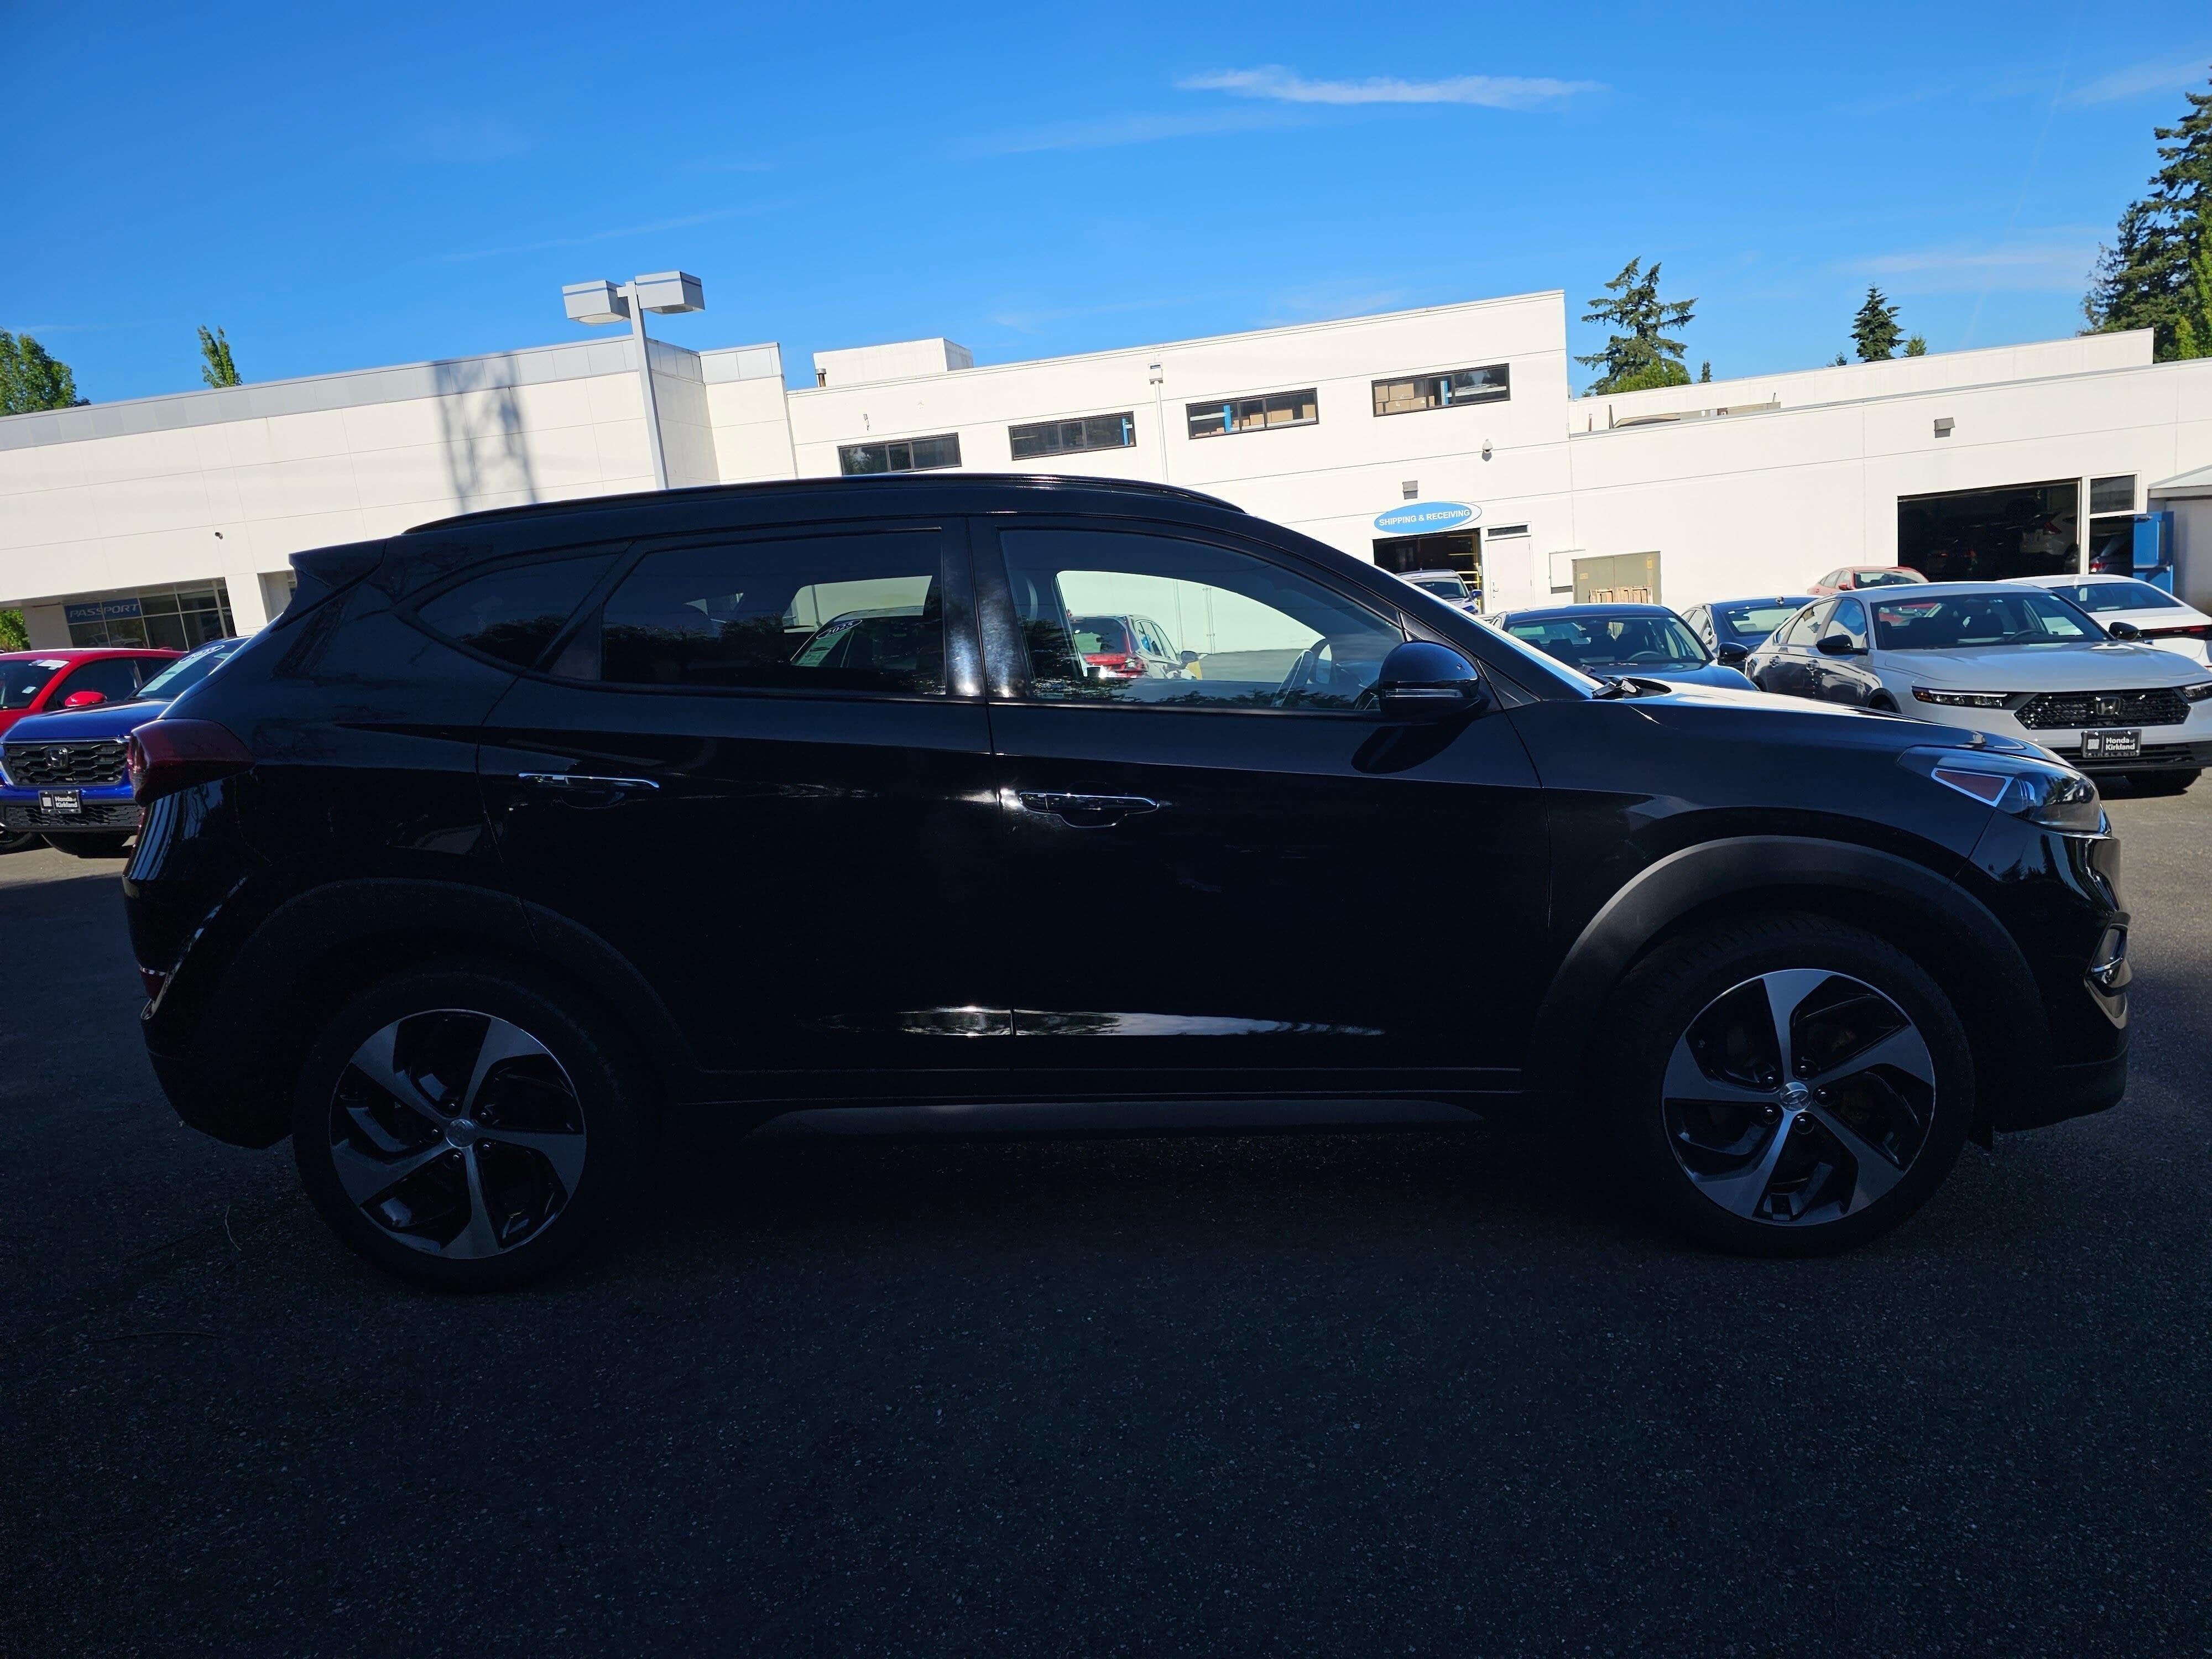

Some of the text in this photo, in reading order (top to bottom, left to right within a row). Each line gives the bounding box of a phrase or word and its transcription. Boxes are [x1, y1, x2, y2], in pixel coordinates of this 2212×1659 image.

[1379, 515, 1417, 526] SHIPPING
[1426, 509, 1470, 520] RECEIVING
[70, 603, 139, 617] PASSPORT
